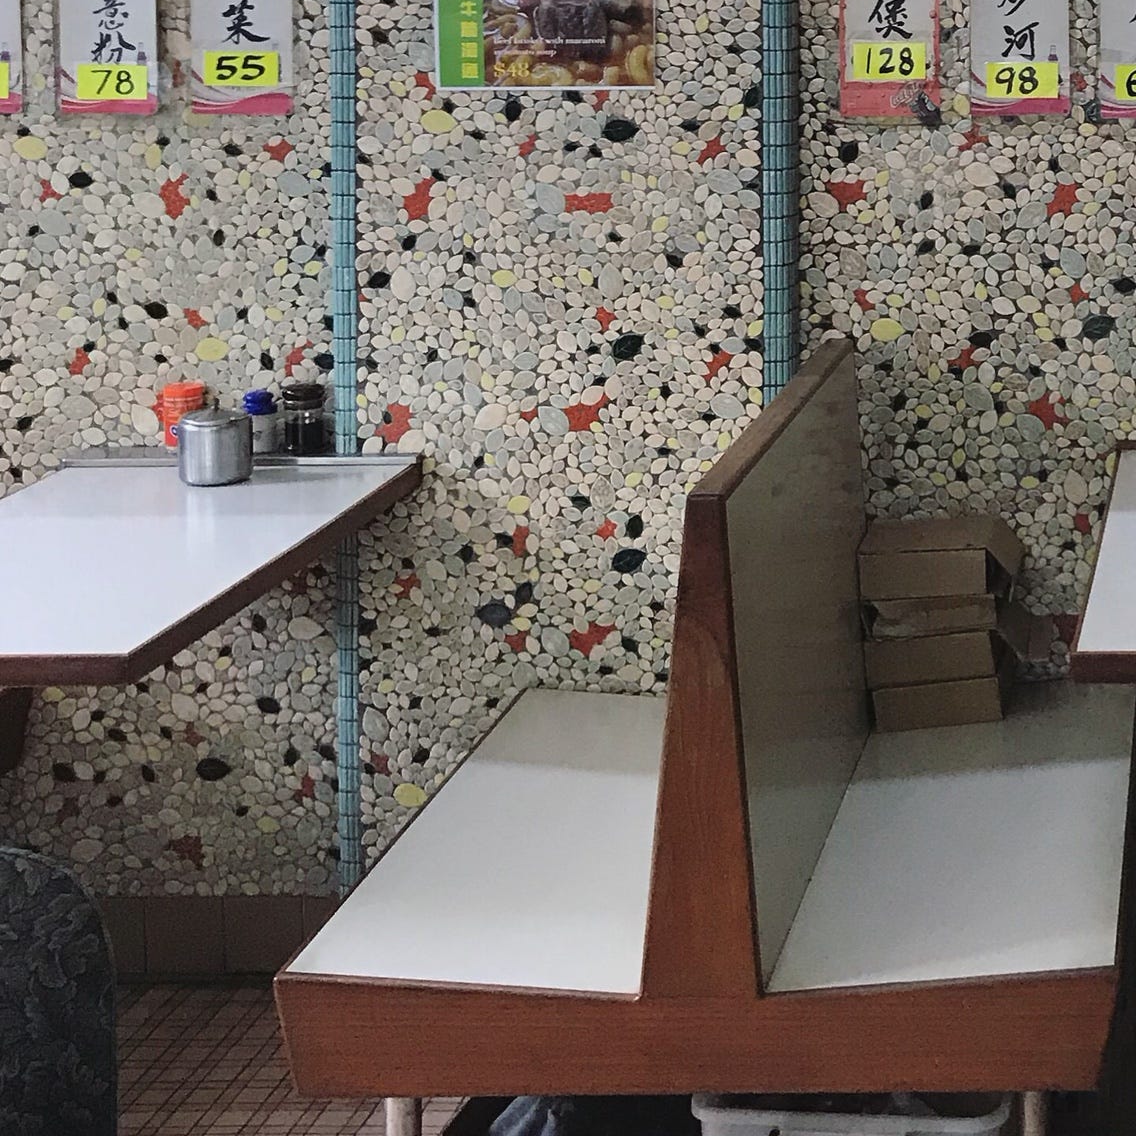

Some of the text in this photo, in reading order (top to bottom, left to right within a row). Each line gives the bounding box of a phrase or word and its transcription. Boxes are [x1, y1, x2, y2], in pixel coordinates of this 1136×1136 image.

[216, 55, 265, 80] 55
[493, 62, 531, 78] $48
[867, 48, 914, 76] 128
[92, 70, 133, 94] 78
[996, 67, 1038, 94] 98
